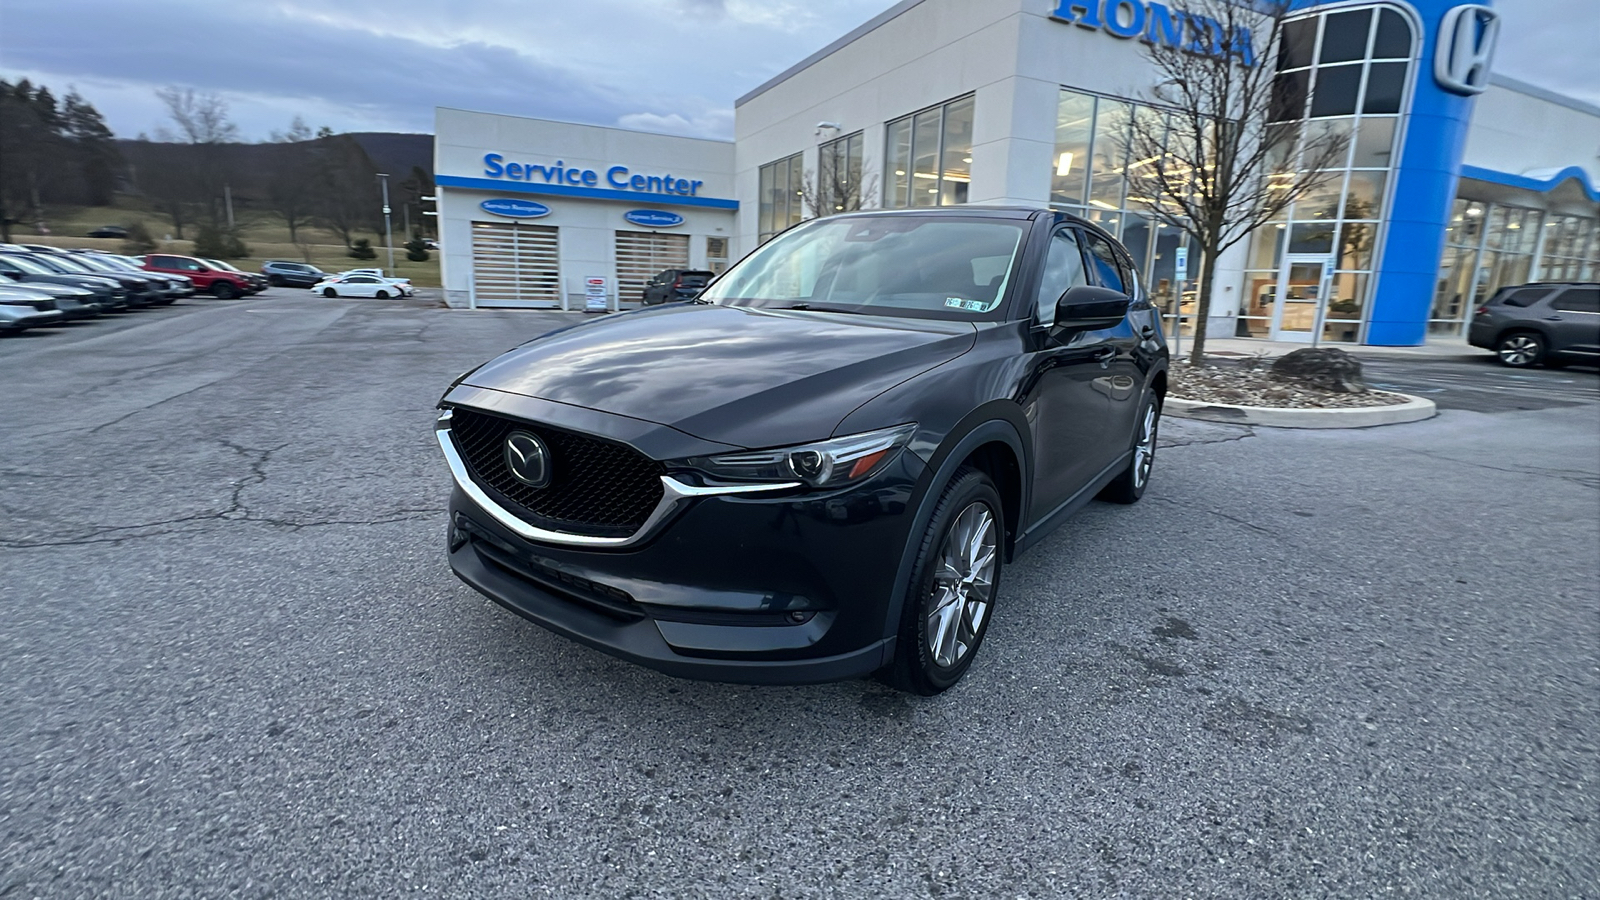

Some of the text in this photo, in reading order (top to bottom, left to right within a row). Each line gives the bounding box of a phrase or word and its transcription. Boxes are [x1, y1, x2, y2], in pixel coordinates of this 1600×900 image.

[1052, 0, 1260, 67] HONDA
[484, 153, 703, 197] Service Center
